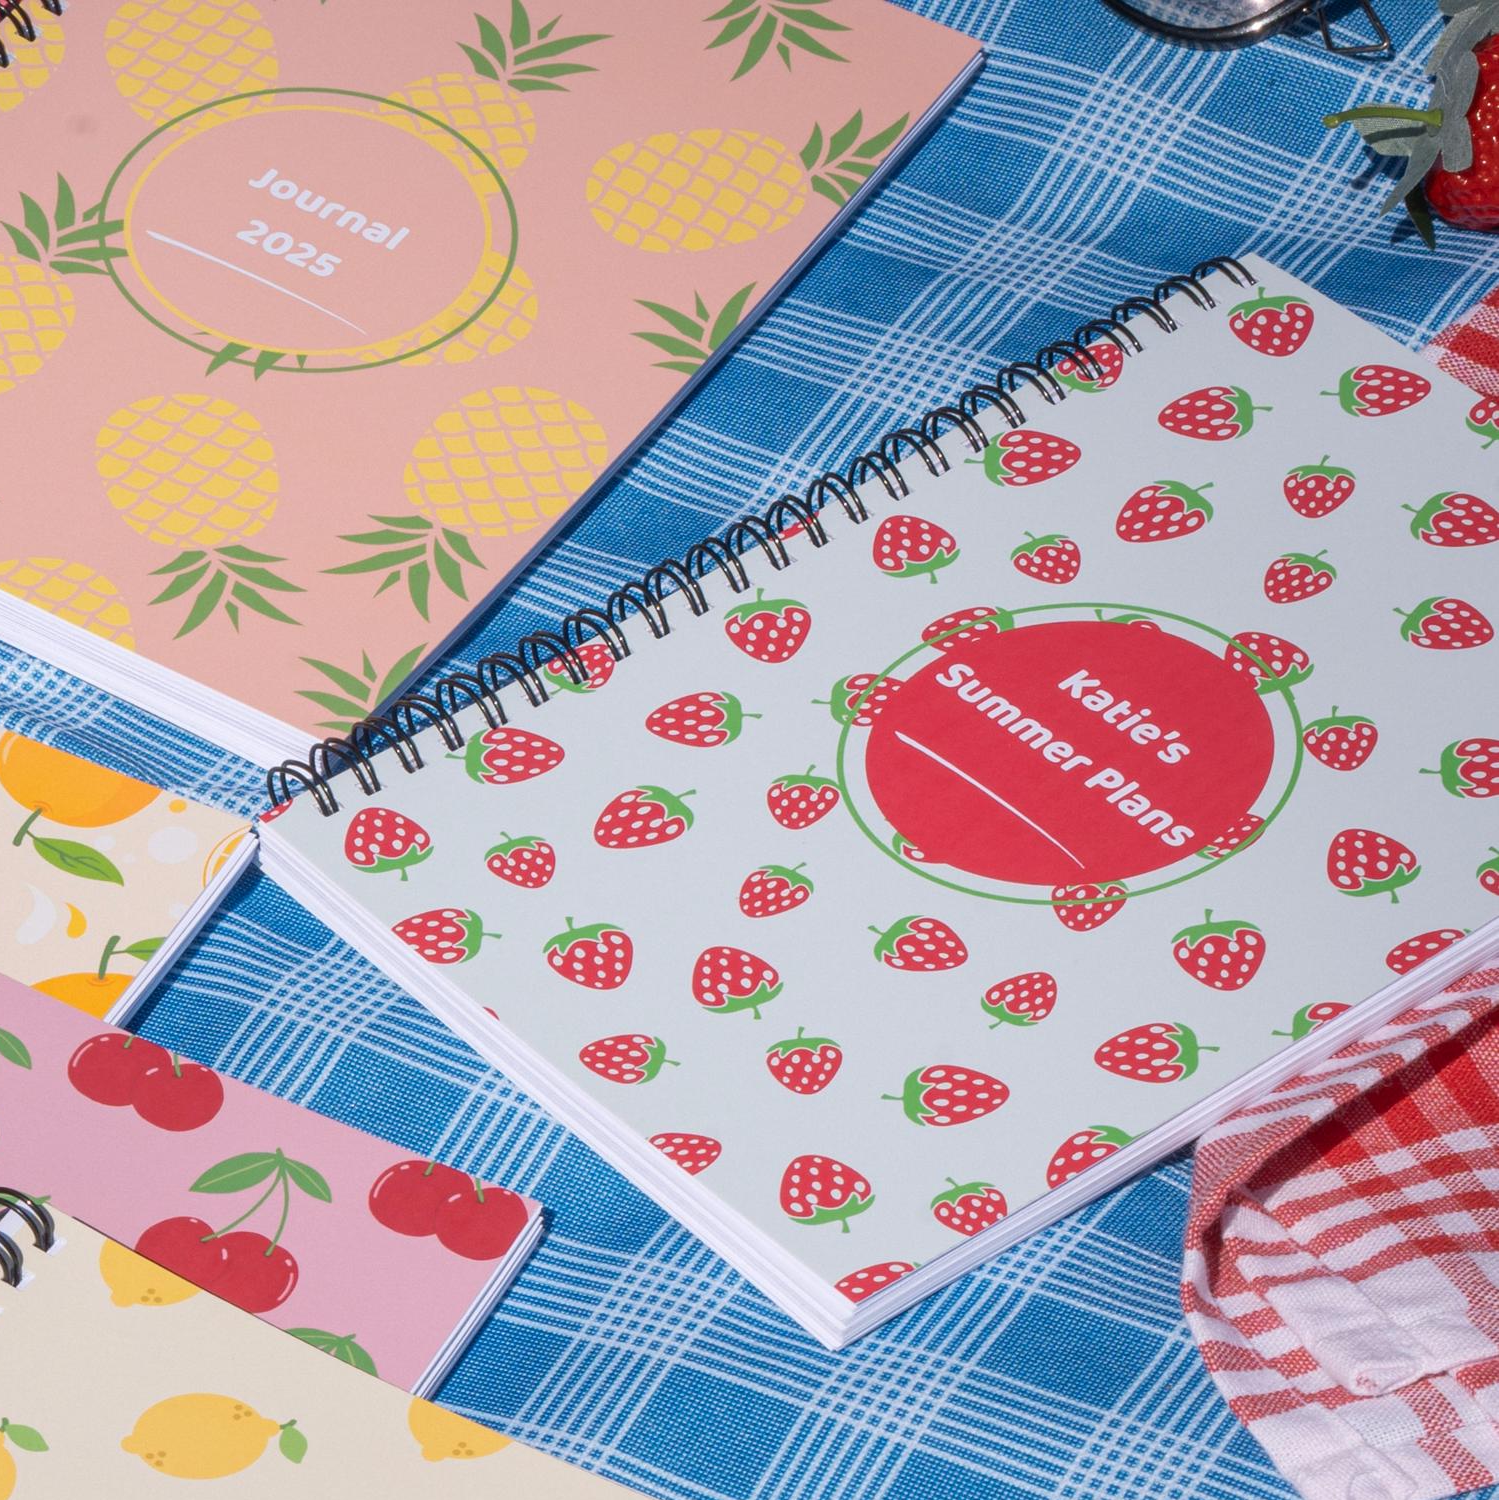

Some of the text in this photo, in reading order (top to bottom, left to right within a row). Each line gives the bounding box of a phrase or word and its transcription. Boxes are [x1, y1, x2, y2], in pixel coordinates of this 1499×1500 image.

[236, 219, 342, 277] 2025
[248, 168, 410, 250] Journal
[935, 663, 1195, 848] Summer Plans
[1057, 669, 1191, 765] Katie's
